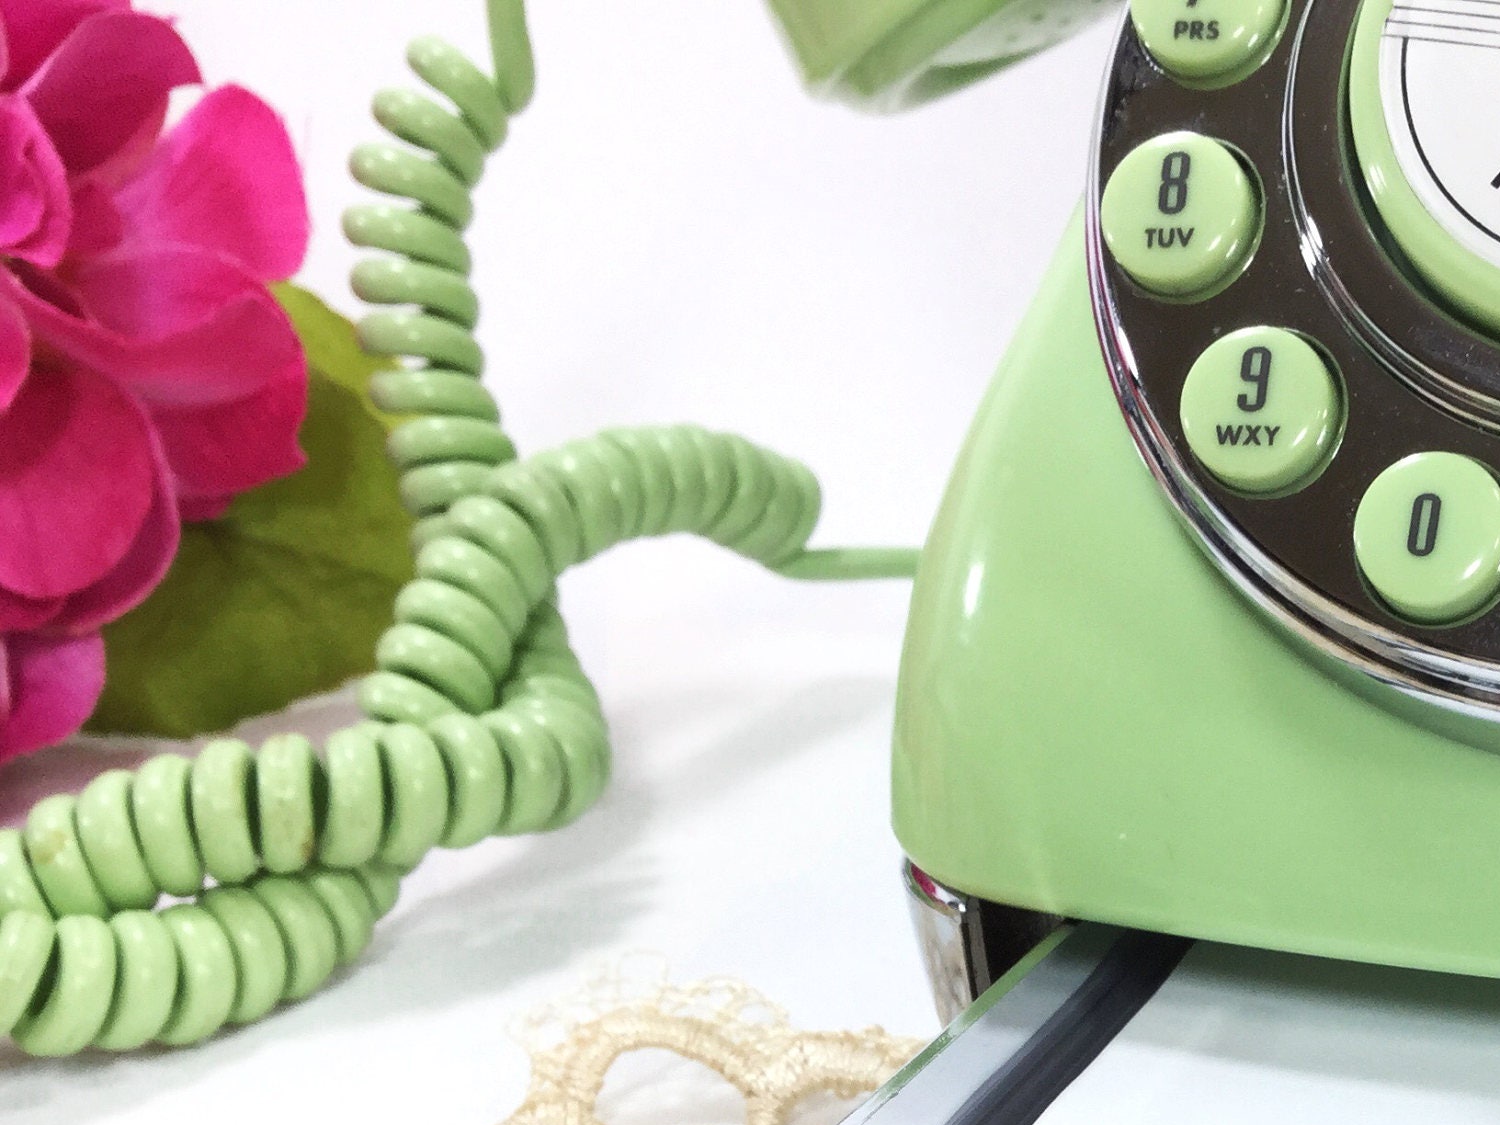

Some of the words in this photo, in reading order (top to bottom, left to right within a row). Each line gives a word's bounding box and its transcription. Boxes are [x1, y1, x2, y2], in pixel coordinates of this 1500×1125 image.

[1173, 20, 1220, 41] PRS
[1157, 151, 1192, 215] 8
[1144, 227, 1195, 249] TUV
[1236, 346, 1273, 413] 9
[1216, 424, 1281, 446] WXY
[1407, 493, 1442, 557] 0
